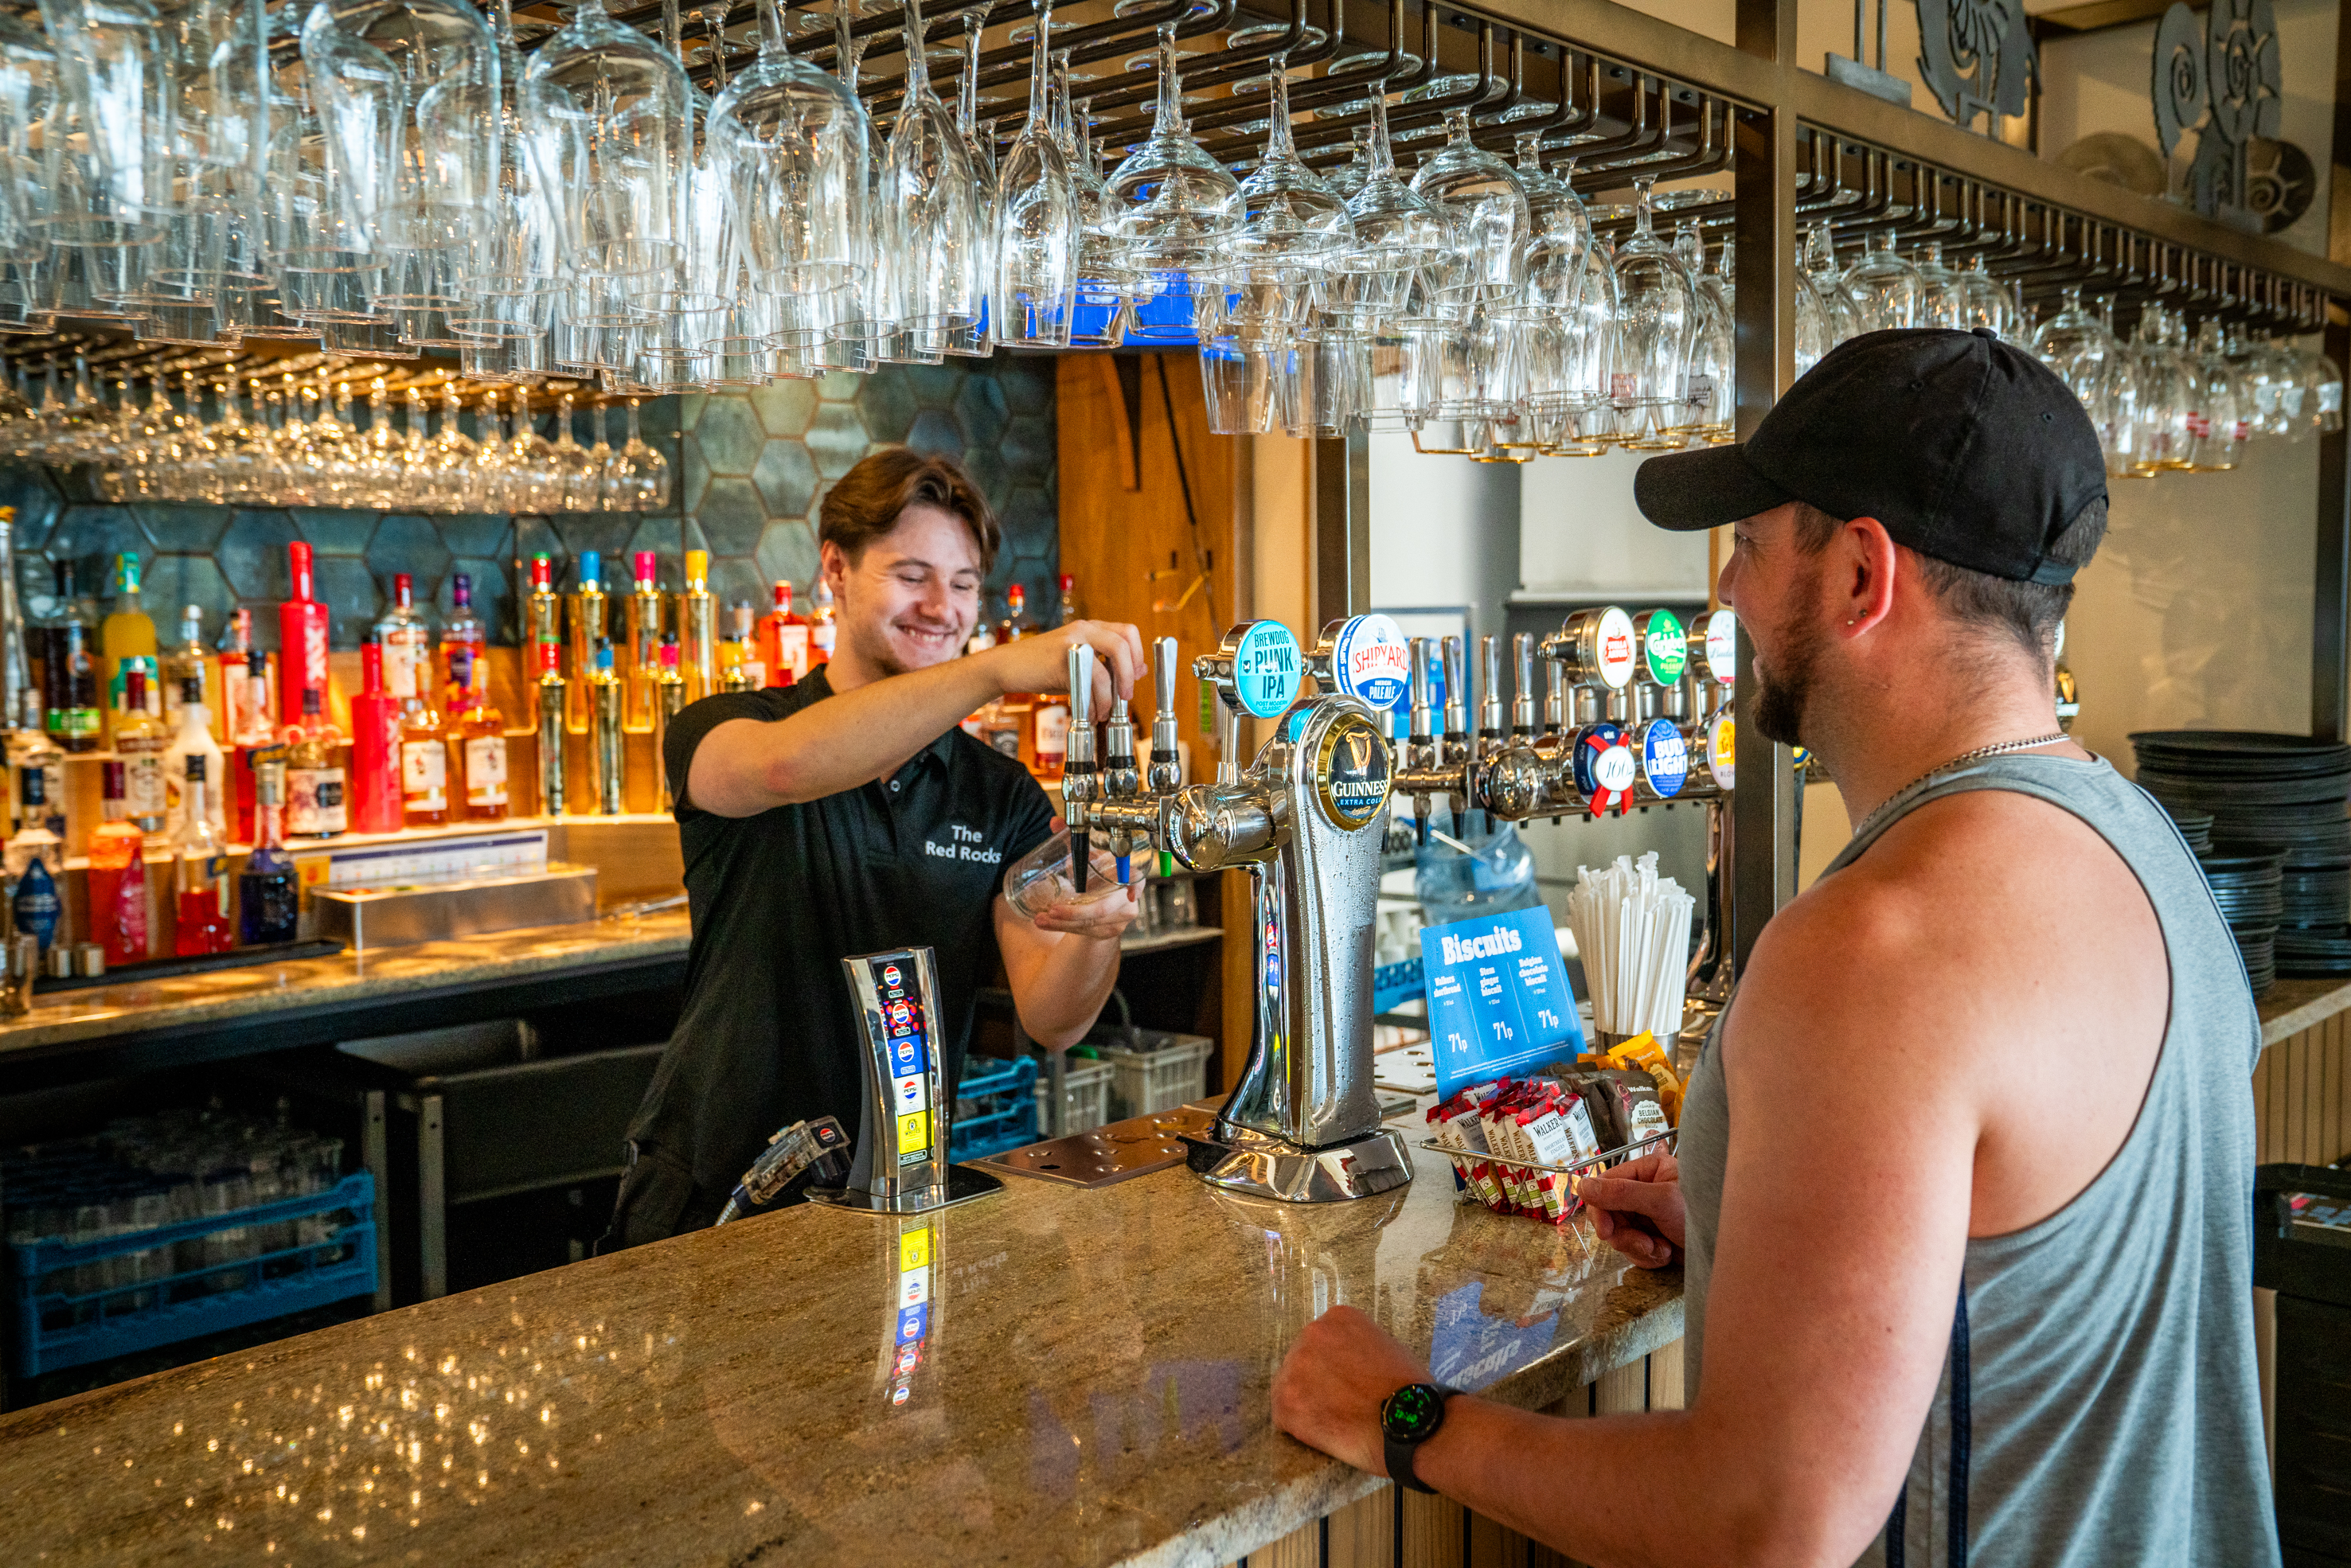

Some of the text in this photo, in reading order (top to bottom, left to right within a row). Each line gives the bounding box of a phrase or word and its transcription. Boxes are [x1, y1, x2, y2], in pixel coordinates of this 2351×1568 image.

[1254, 630, 1290, 648] BREWDOG
[1255, 646, 1294, 674] PUNK
[1354, 645, 1408, 673] SHIPYARD
[1263, 675, 1285, 699] IPA
[1369, 685, 1396, 700] PALE ALE
[1653, 737, 1685, 759] BUD
[1333, 779, 1388, 798] GUINNESS
[1365, 797, 1383, 805] COLD
[951, 825, 982, 843] The
[925, 840, 1002, 864] Red Rocks
[1441, 926, 1522, 965] Biscuits
[1518, 956, 1544, 968] Belgian
[1479, 967, 1495, 977] Stem
[1519, 965, 1548, 978] chocolate
[1525, 973, 1548, 986] biscuit
[1434, 983, 1461, 997] shortbread
[1435, 976, 1455, 986] Walkers
[1480, 976, 1499, 989] ginger
[1481, 984, 1502, 997] biscuit
[1537, 1008, 1560, 1028] 71p
[1492, 1021, 1513, 1041] 71p
[1448, 1032, 1468, 1053] 71p
[1550, 1143, 1565, 1155] FINGERS
[1564, 1127, 1580, 1160] WALKER'S
